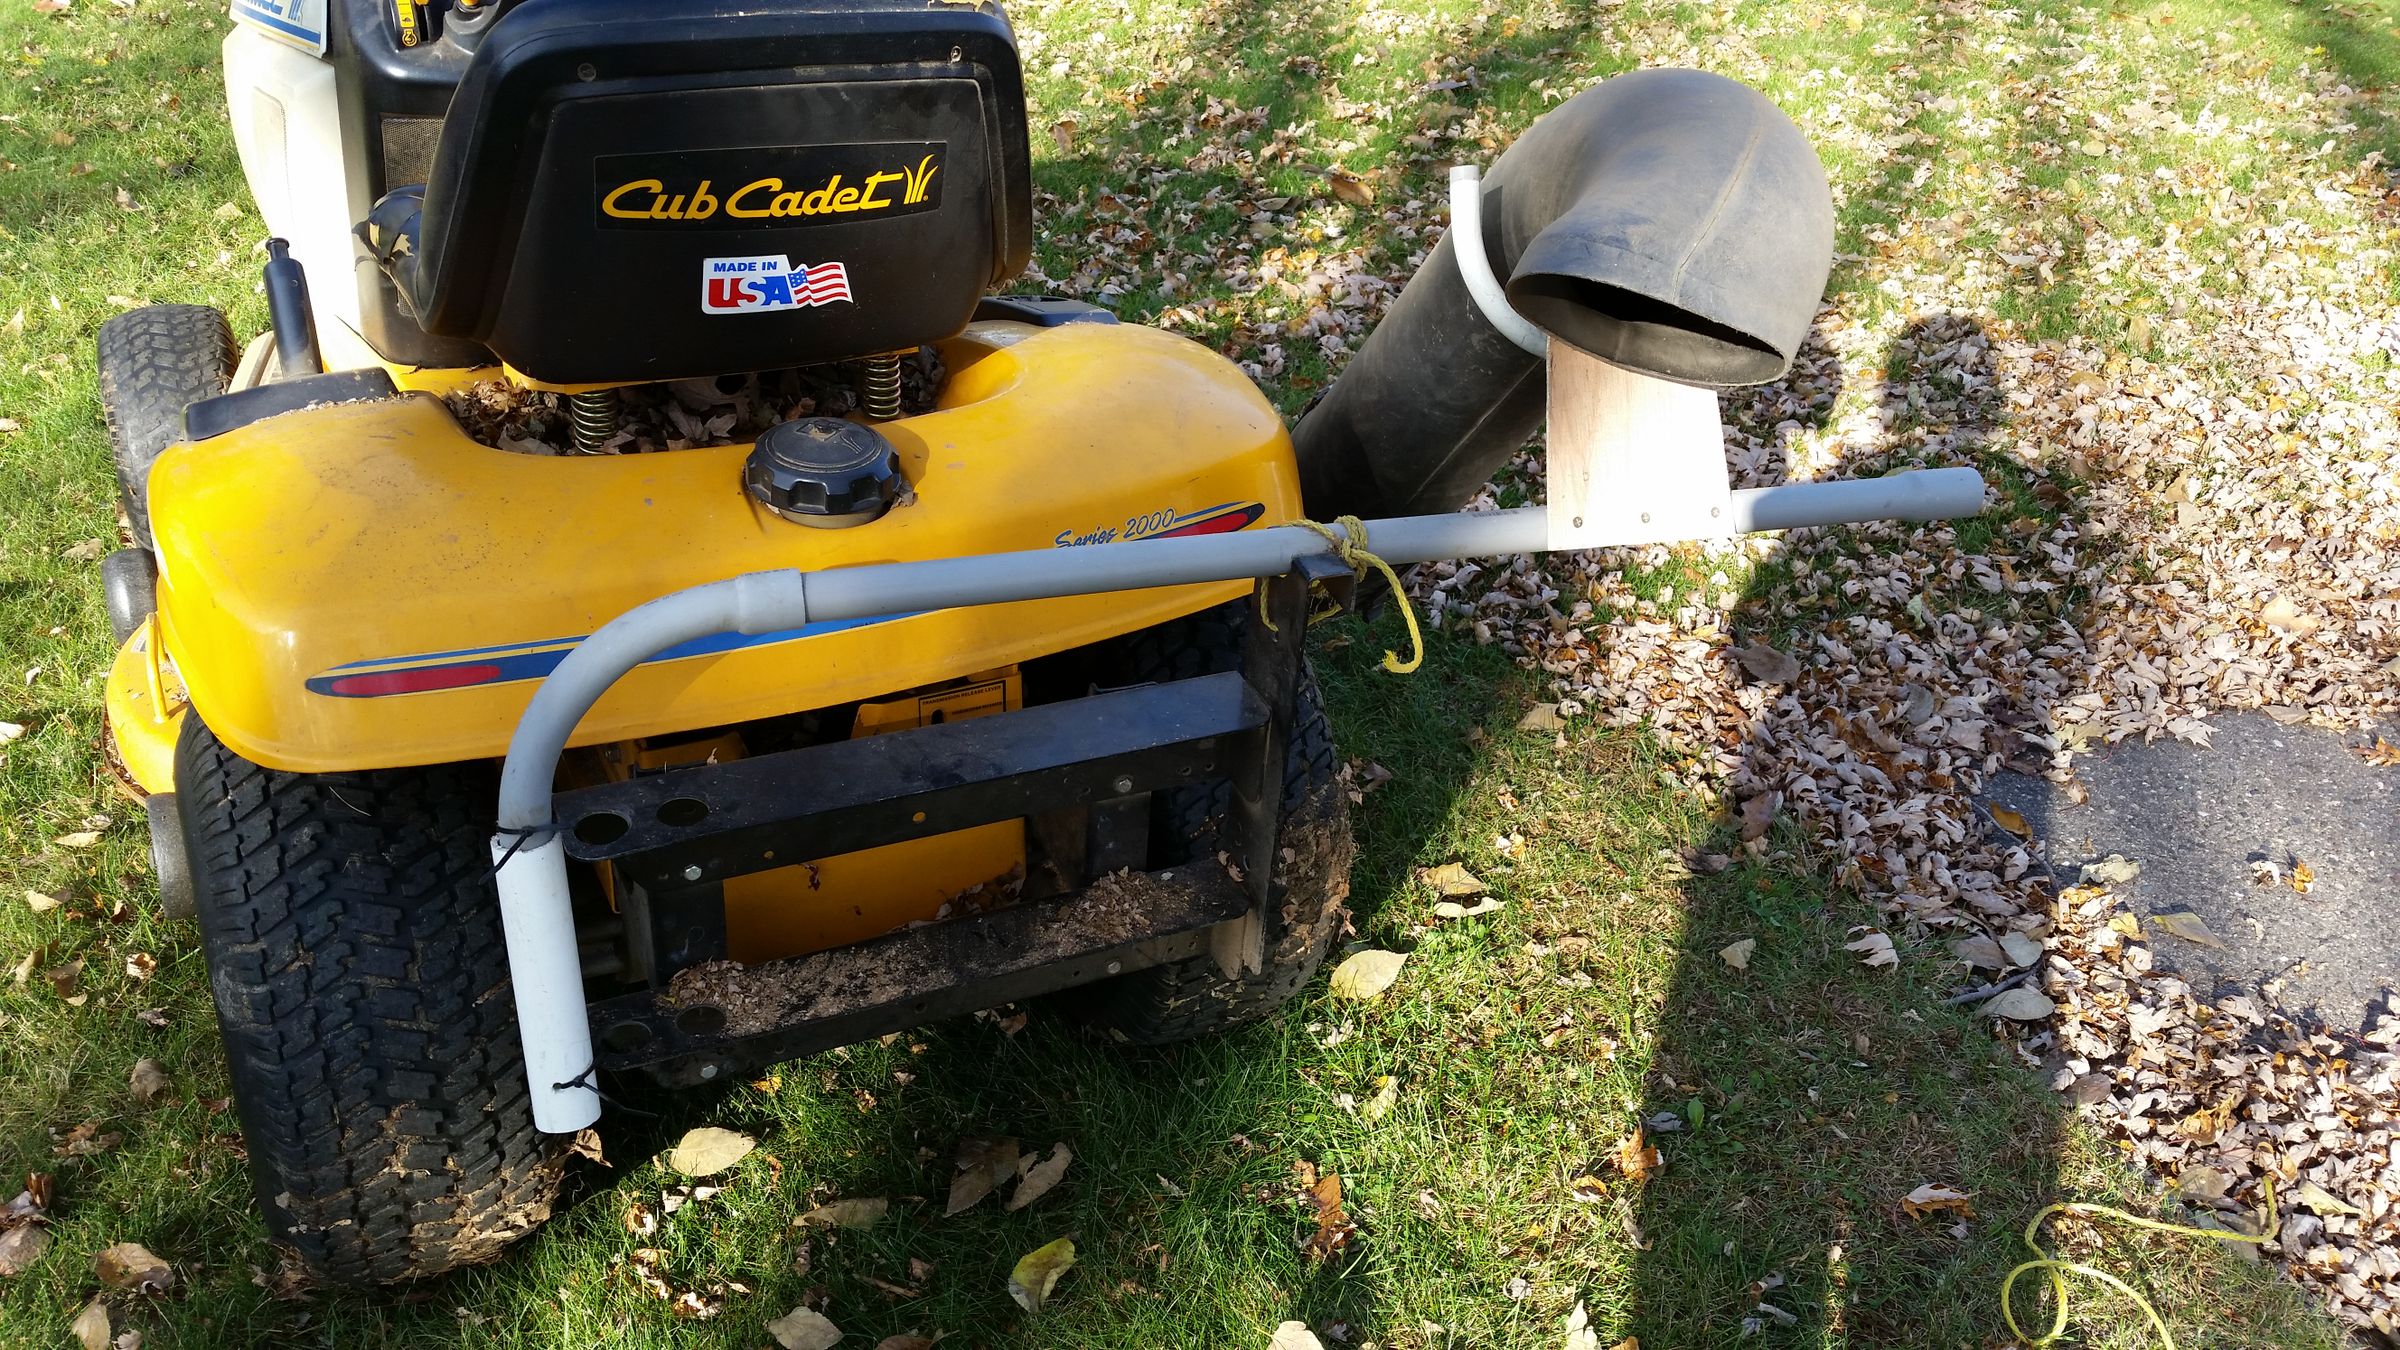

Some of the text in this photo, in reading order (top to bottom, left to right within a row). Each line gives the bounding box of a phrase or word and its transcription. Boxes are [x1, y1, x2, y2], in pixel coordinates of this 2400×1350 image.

[602, 170, 904, 220] Cub Cadet
[713, 260, 778, 273] MADE IN
[708, 275, 794, 308] USA
[1054, 507, 1175, 549] Series 2000
